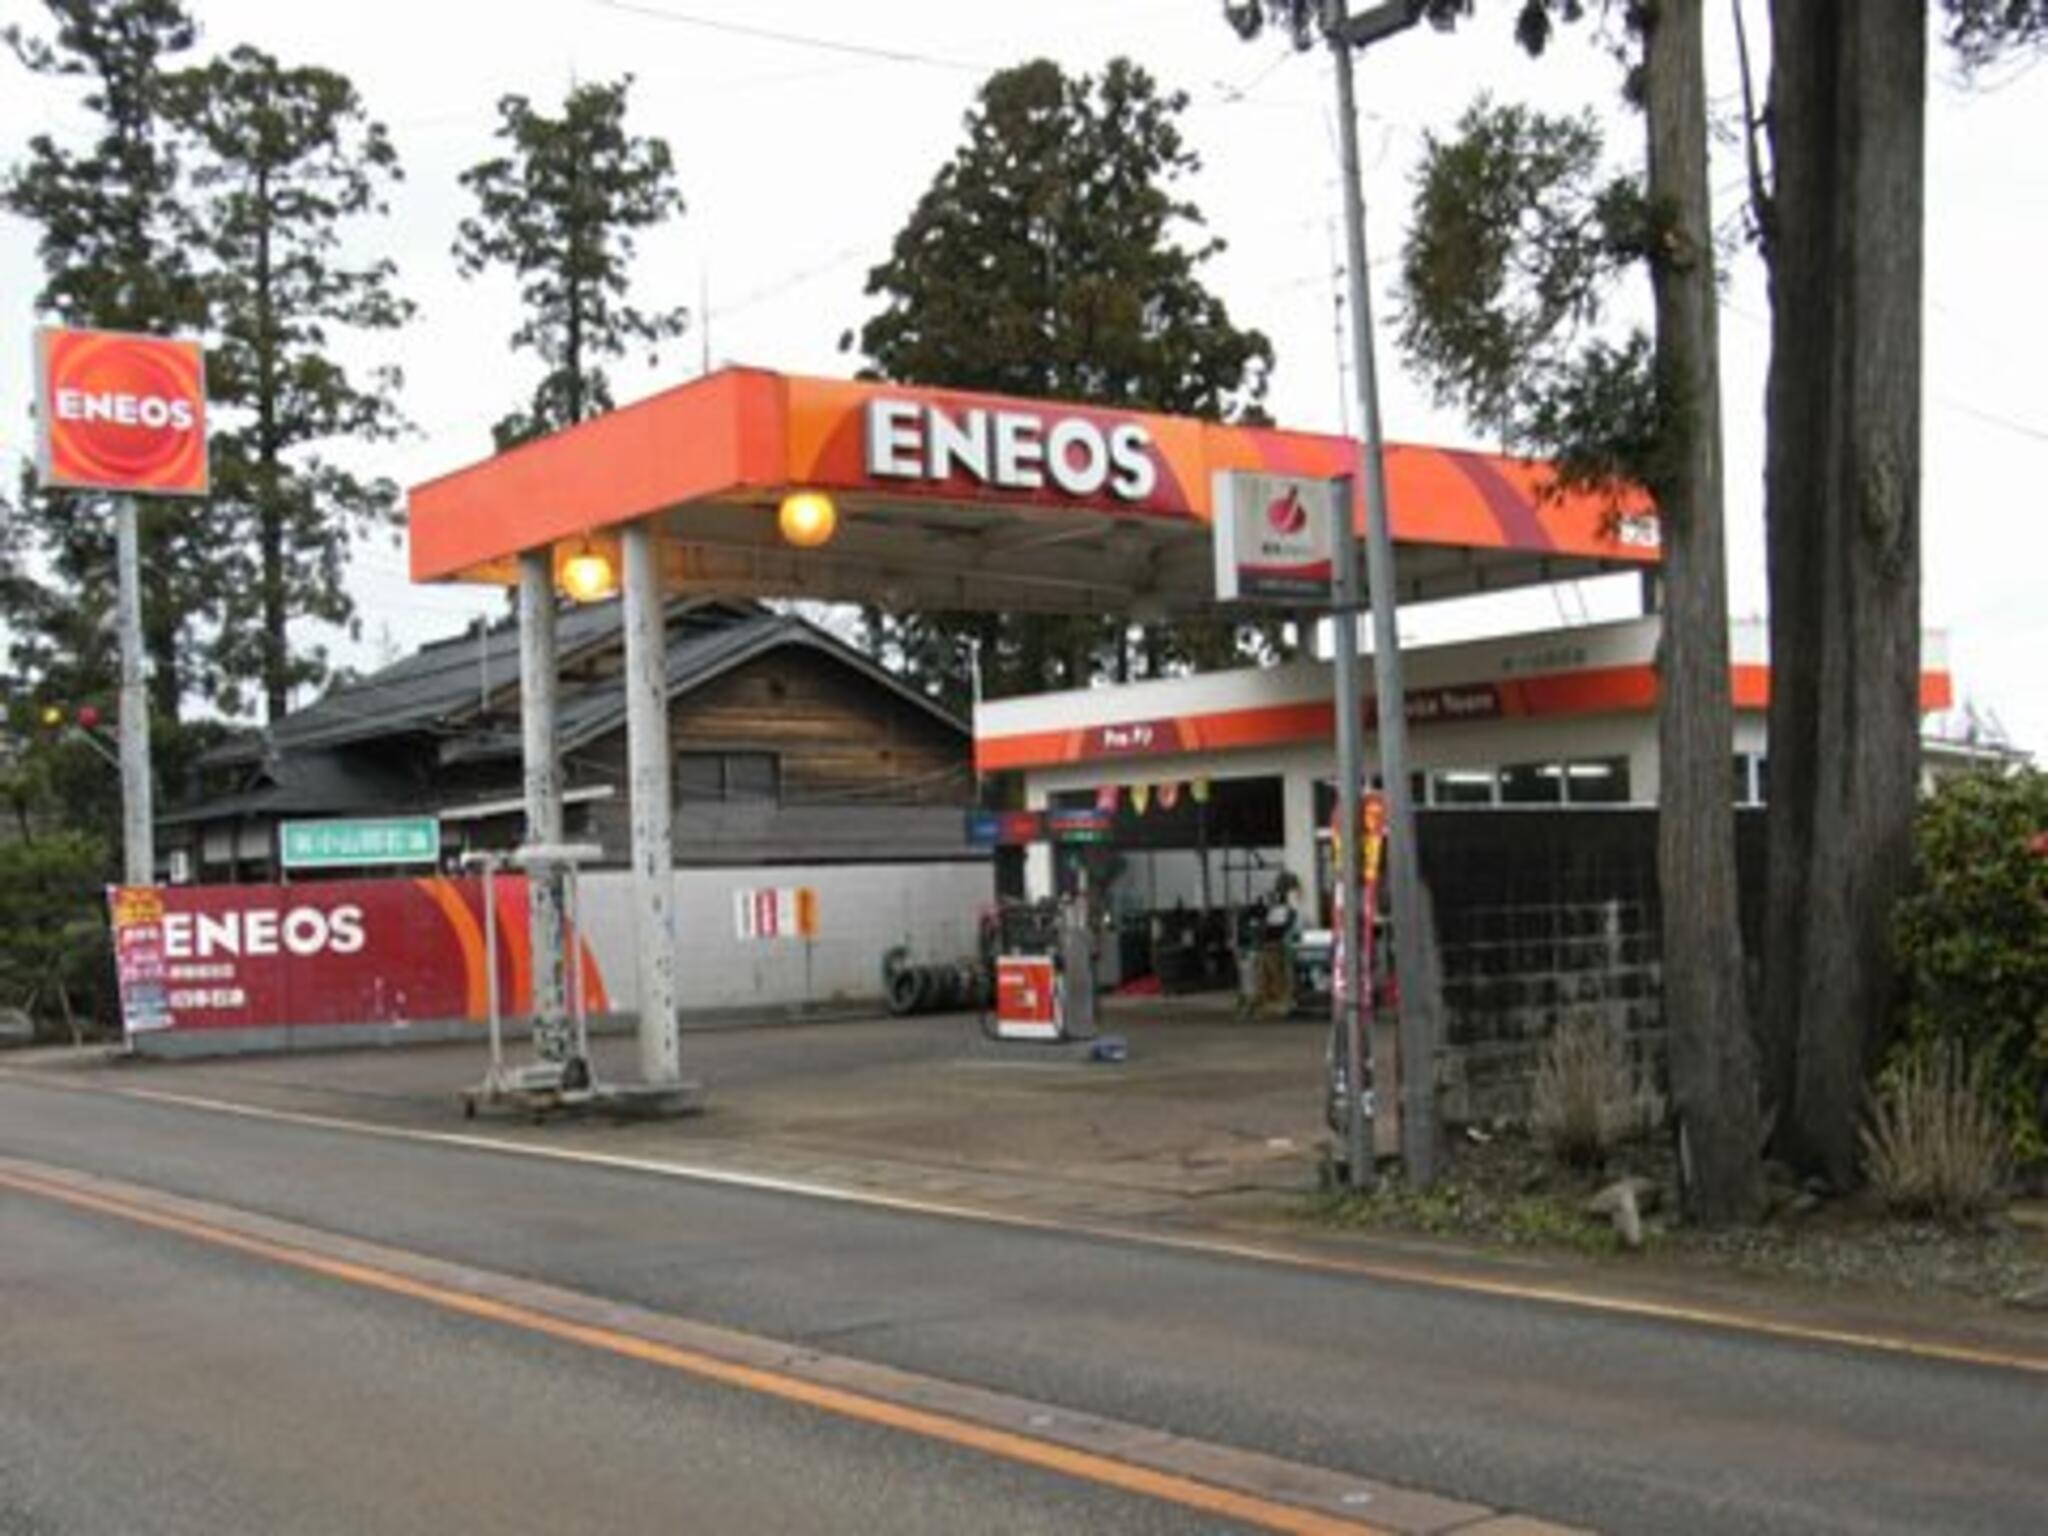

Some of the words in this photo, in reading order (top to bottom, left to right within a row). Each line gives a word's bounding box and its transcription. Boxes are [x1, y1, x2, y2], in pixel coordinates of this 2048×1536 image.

[56, 388, 193, 431] ENEOS
[867, 398, 1157, 500] ENEOS
[163, 904, 365, 957] ENEOS
